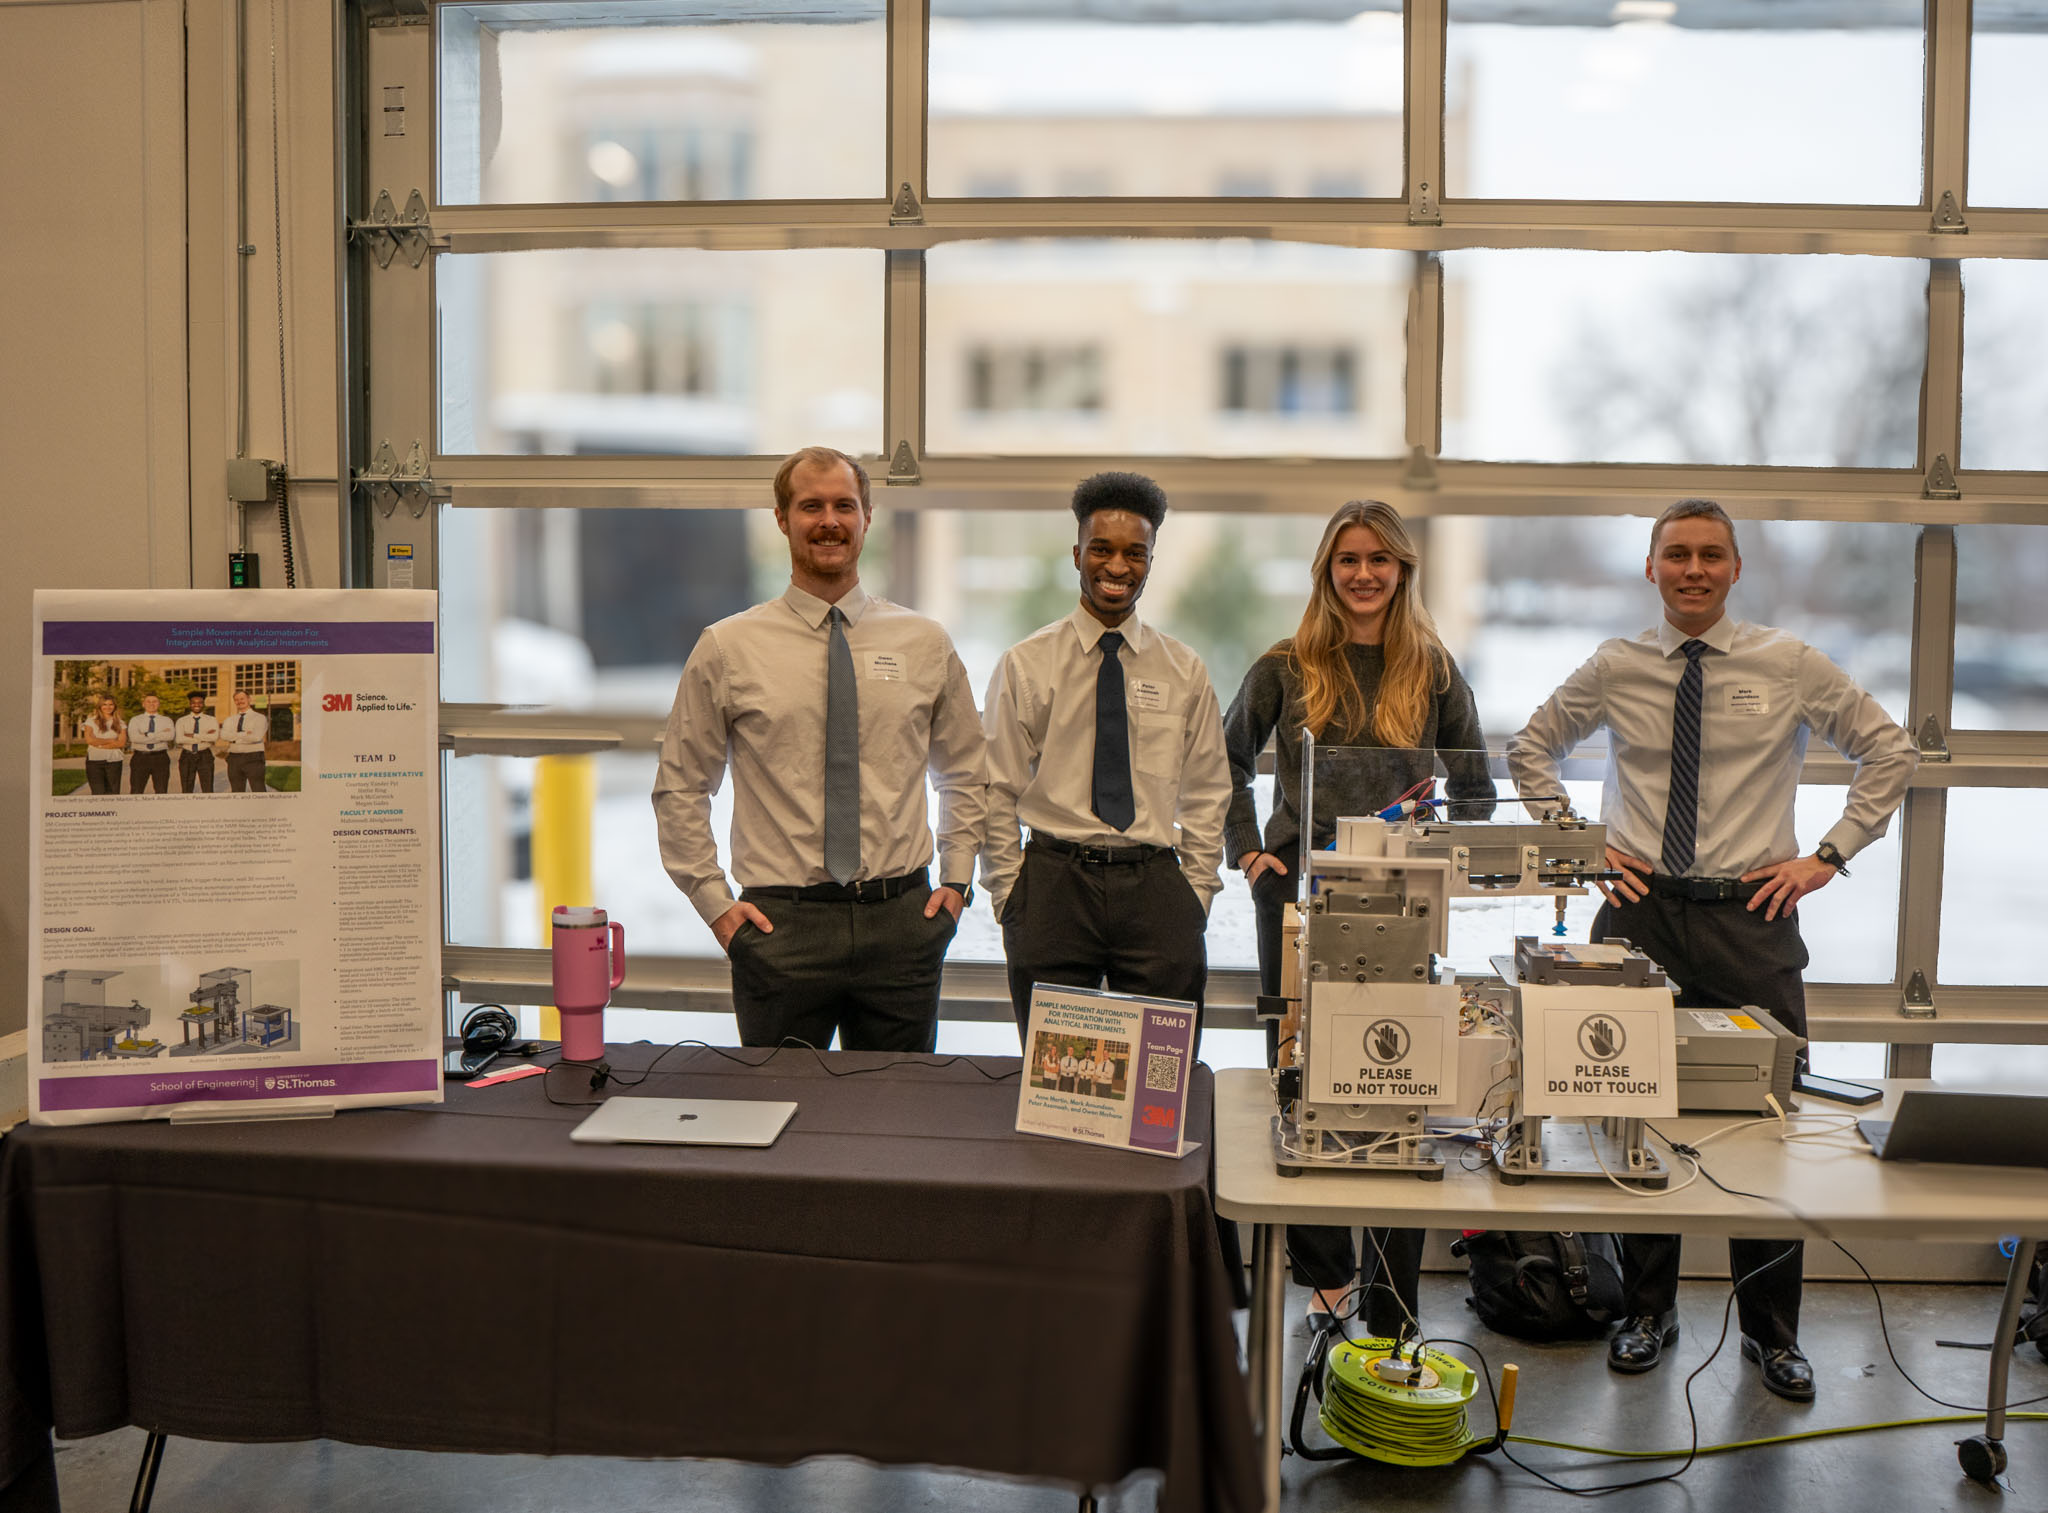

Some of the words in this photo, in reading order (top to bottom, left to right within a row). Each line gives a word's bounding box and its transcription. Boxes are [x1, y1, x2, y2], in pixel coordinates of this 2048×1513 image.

[171, 628, 203, 638] Sample
[206, 628, 251, 637] Movement
[254, 628, 303, 637] Automation
[305, 628, 319, 636] For
[166, 639, 212, 648] Integration
[237, 639, 278, 648] Analytical
[280, 639, 328, 647] Instruments
[322, 694, 352, 712] 3M
[356, 694, 388, 702] Science.
[356, 704, 386, 712] Applied
[354, 754, 383, 763] TEAM
[388, 754, 396, 762] D
[1035, 1000, 1060, 1010] SAMPLE
[1060, 1003, 1096, 1014] MOVEMENT
[1096, 1007, 1138, 1019] AUTOMATION
[1048, 1010, 1060, 1018] FOR
[1062, 1011, 1104, 1024] INTEGRATION
[1104, 1016, 1121, 1025] WITH
[1151, 1015, 1177, 1028] TEAM
[1179, 1018, 1186, 1028] D
[1044, 1018, 1081, 1030] ANALYTICAL
[1082, 1022, 1126, 1034] INSTRUMENTS
[1147, 1042, 1165, 1052] Team
[1166, 1044, 1184, 1055] Page
[1359, 1068, 1412, 1080] PLEASE
[1575, 1065, 1630, 1078] PLEASE
[150, 1080, 183, 1092] School
[185, 1080, 196, 1090] of
[197, 1078, 255, 1090] Engineering
[1333, 1083, 1352, 1096] DO
[1356, 1083, 1386, 1096] NOT
[1390, 1083, 1438, 1096] TOUCH
[1548, 1081, 1568, 1094] DO
[1574, 1081, 1602, 1094] NOT
[1606, 1081, 1656, 1094] TOUCH
[1142, 1105, 1175, 1128] 3M
[1358, 1376, 1398, 1394] CORD
